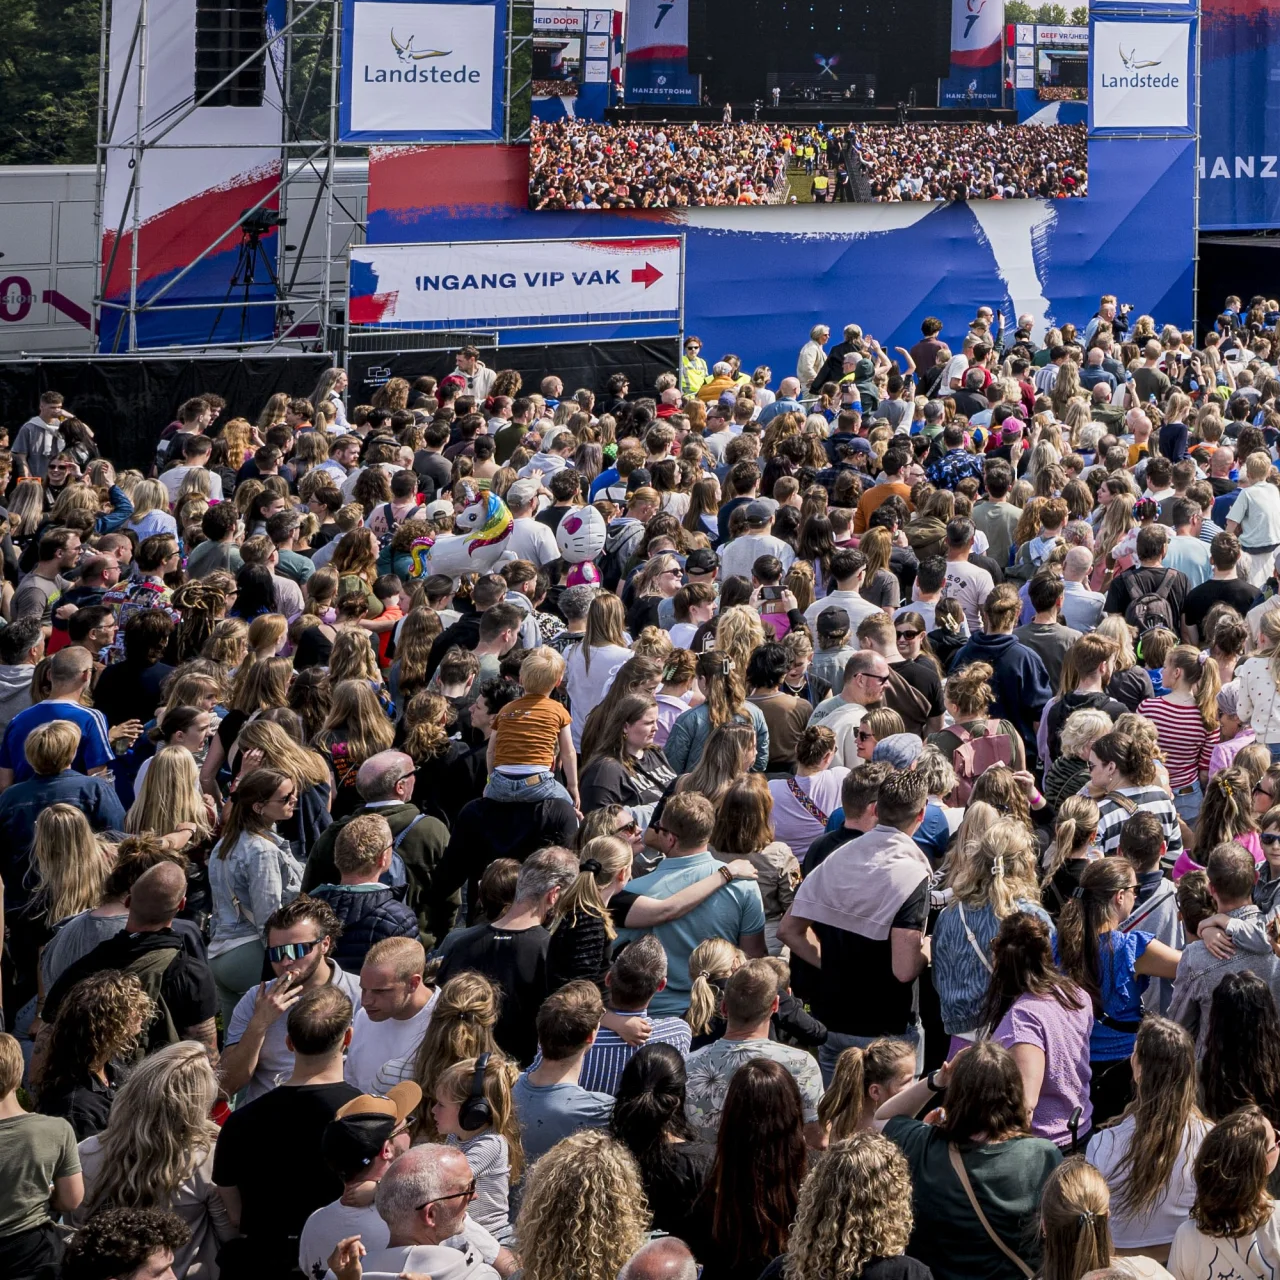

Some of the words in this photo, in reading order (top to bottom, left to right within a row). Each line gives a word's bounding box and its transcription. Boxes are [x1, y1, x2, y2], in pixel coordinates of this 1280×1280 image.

[553, 17, 579, 25] DOOR
[364, 65, 481, 84] Landstede
[1101, 72, 1179, 89] Landstede
[632, 87, 692, 95] HANZESTROHM
[415, 272, 517, 291] INGANG
[524, 271, 565, 288] VIP
[571, 269, 621, 286] VAK
